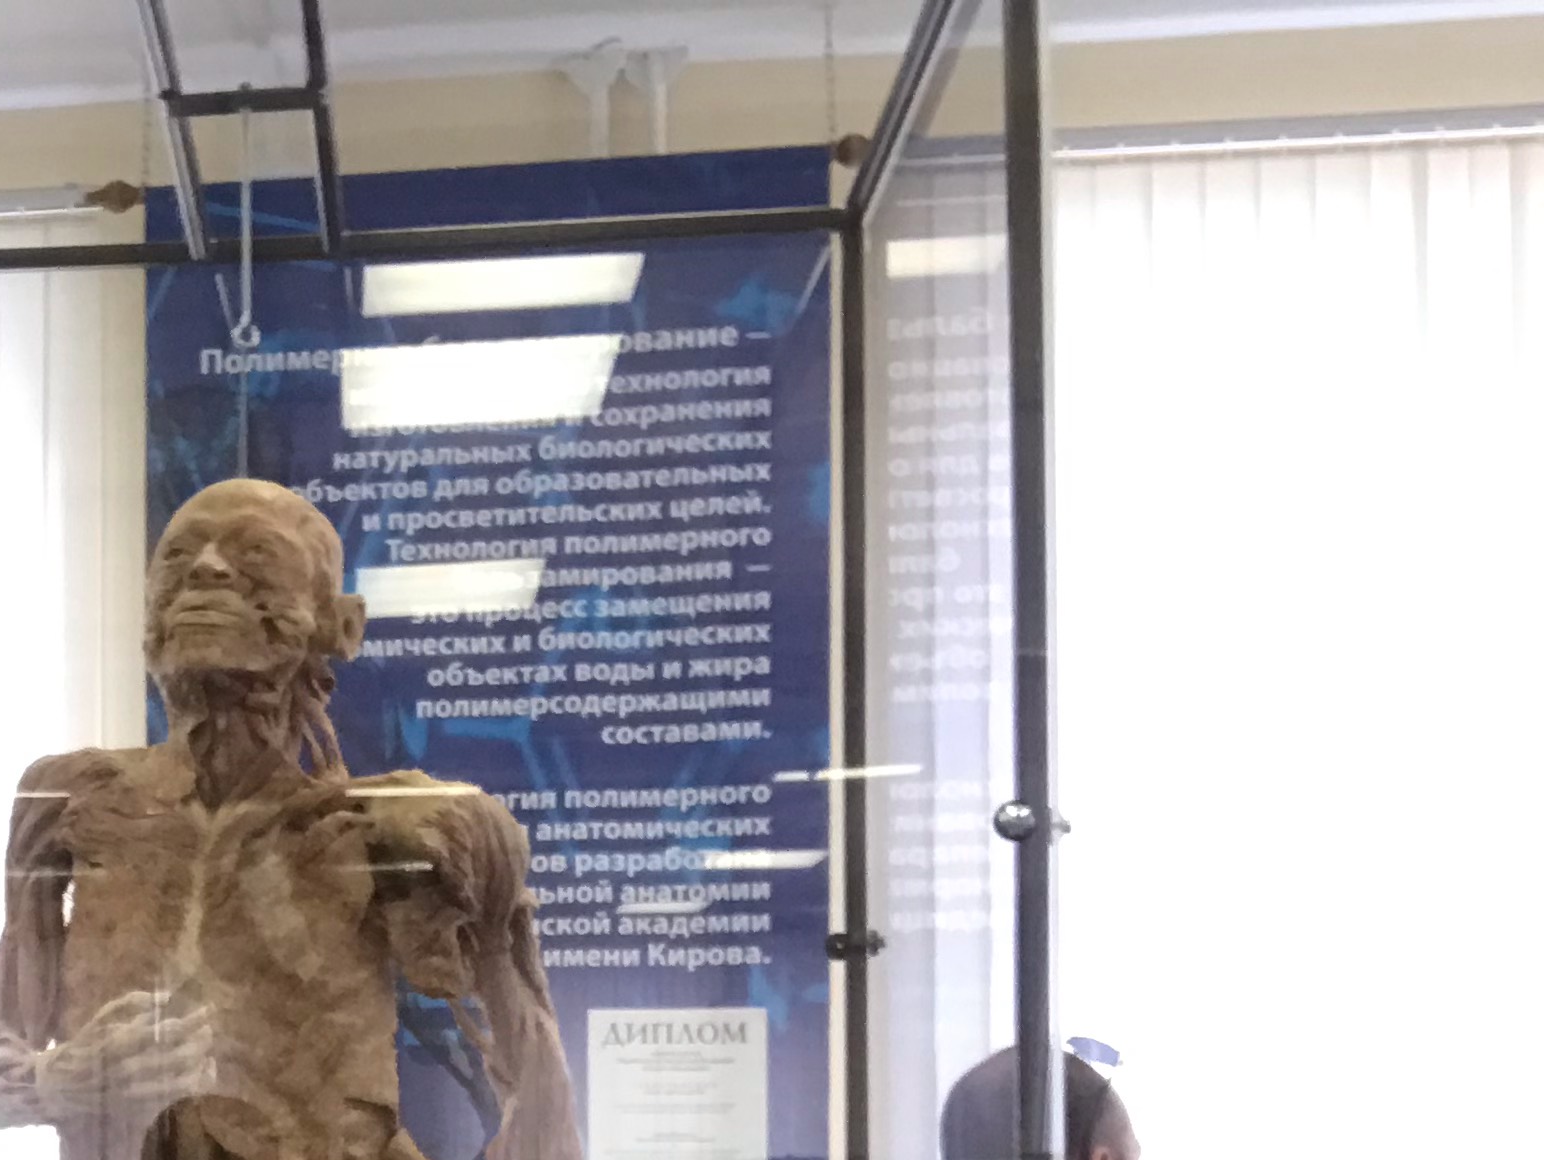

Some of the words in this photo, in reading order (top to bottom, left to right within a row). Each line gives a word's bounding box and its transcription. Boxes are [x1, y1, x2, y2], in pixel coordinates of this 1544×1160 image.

[199, 349, 344, 376] Полимер
[609, 366, 772, 393] ехнология
[333, 443, 532, 474] натуральных
[538, 430, 772, 460] биологических
[433, 478, 489, 501] для
[495, 463, 772, 499] образовательных
[362, 513, 380, 531] и
[388, 502, 663, 536] просветительских
[670, 489, 771, 521] целей.
[386, 537, 557, 562] Технология
[564, 527, 772, 556] полимерного
[539, 561, 732, 593] амирования
[595, 591, 772, 618] замещения
[361, 635, 505, 659] мических
[513, 634, 532, 652] и
[538, 623, 772, 651] биологических
[426, 662, 568, 687] объектах
[574, 662, 655, 686] воды
[661, 661, 683, 680] и
[688, 656, 771, 681] жира
[416, 688, 771, 722] полимерсодержащими
[600, 720, 773, 744] составами.
[564, 784, 772, 812] полимерного
[536, 817, 772, 841] анатомических
[620, 882, 772, 903] анатомии
[618, 913, 772, 938] академии
[543, 948, 641, 967] имени
[647, 943, 772, 972] Кирова.
[601, 1022, 749, 1049] ДИПЛОМ
